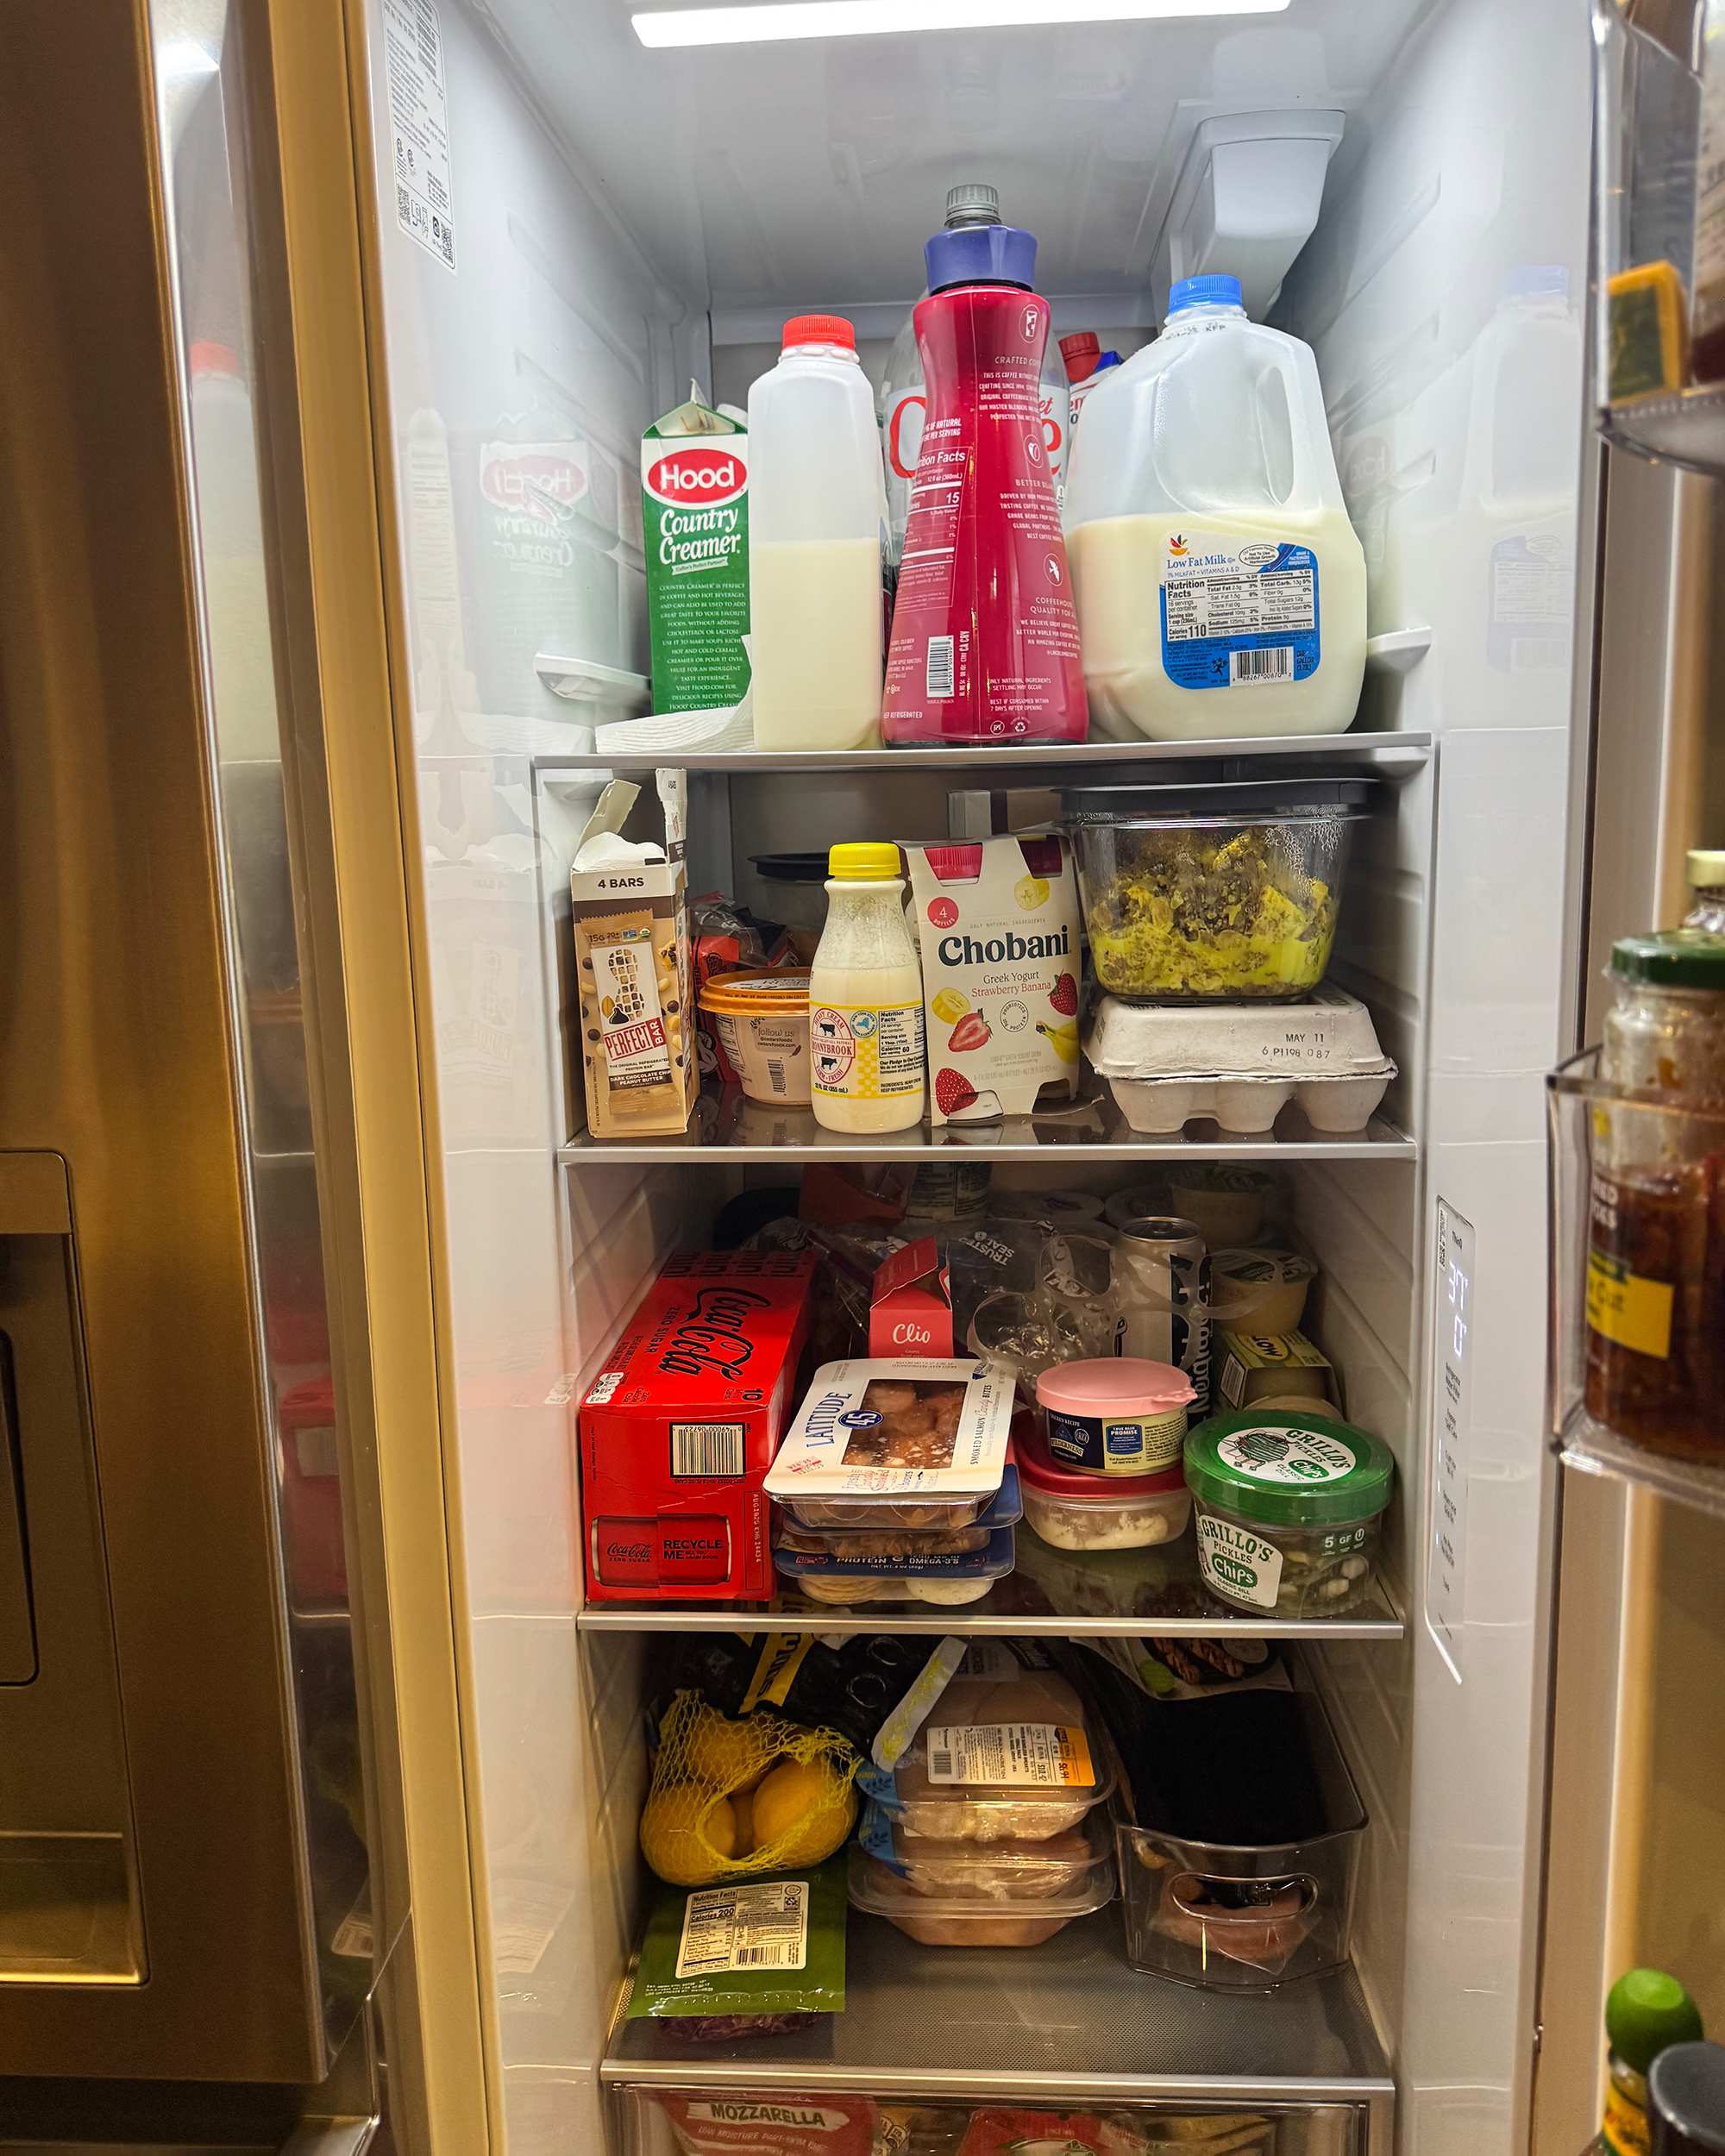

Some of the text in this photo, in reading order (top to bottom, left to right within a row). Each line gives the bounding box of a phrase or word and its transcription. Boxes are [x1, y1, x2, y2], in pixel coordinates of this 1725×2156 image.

[936, 417, 962, 429] NATURAL
[938, 429, 961, 438] SERVING
[938, 451, 966, 463] Facts
[660, 461, 735, 493] Hood
[1015, 479, 1041, 487] BETTER
[946, 492, 960, 505] 15
[660, 508, 738, 536] Country
[1167, 554, 1226, 569] Low Fat Milk
[1167, 580, 1205, 591] Nutrition
[1168, 590, 1192, 599] Facts
[1030, 605, 1060, 615] QUALITY
[959, 630, 969, 642] CRV
[1189, 624, 1207, 637] 110
[890, 711, 923, 719] REFRIGERATED
[597, 877, 645, 889] 4 BARS
[938, 906, 948, 918] 4
[933, 917, 956, 927] BOTTLES
[588, 934, 605, 943] 15G
[938, 924, 1070, 967] Chobani
[983, 971, 1040, 984] Greek Yogurt
[971, 981, 1052, 998] Strawberry Banana
[826, 1012, 845, 1030] CREAM
[758, 1027, 782, 1037] follow
[1285, 1033, 1325, 1044] MAY 11
[605, 1019, 664, 1059] PERFECT BAR
[1262, 1045, 1270, 1056] 6
[625, 1071, 659, 1081] CHOCOLATE
[828, 1069, 844, 1081] FRESH
[644, 1307, 681, 1354] ZERO SUGAR
[658, 1287, 772, 1382] Coca-Cola
[893, 1323, 931, 1344] Clio
[742, 1388, 765, 1401] 10
[983, 1384, 993, 1399] BITES
[806, 1392, 853, 1448] LATITUDE
[845, 1412, 876, 1426] 45
[975, 1415, 986, 1437] SALMON
[969, 1437, 982, 1464] SMOKED
[1285, 1429, 1352, 1469] GRILLO'S
[1294, 1440, 1327, 1463] PICKLES
[1294, 1460, 1323, 1479] Chips
[662, 1539, 724, 1550] RECYCLE
[1201, 1518, 1274, 1562] GRILLO'S
[1324, 1535, 1352, 1549] 5 GF
[606, 1542, 652, 1558] Coca-Cola
[662, 1550, 685, 1560] ME
[1214, 1540, 1252, 1564] PICKLES
[836, 1556, 887, 1564] PROTEIN
[1214, 1557, 1254, 1584] Chips
[691, 1908, 735, 1921] Calories 200
[710, 2103, 826, 2127] MOZZARELLA
[717, 2129, 760, 2140] MOISTURE
